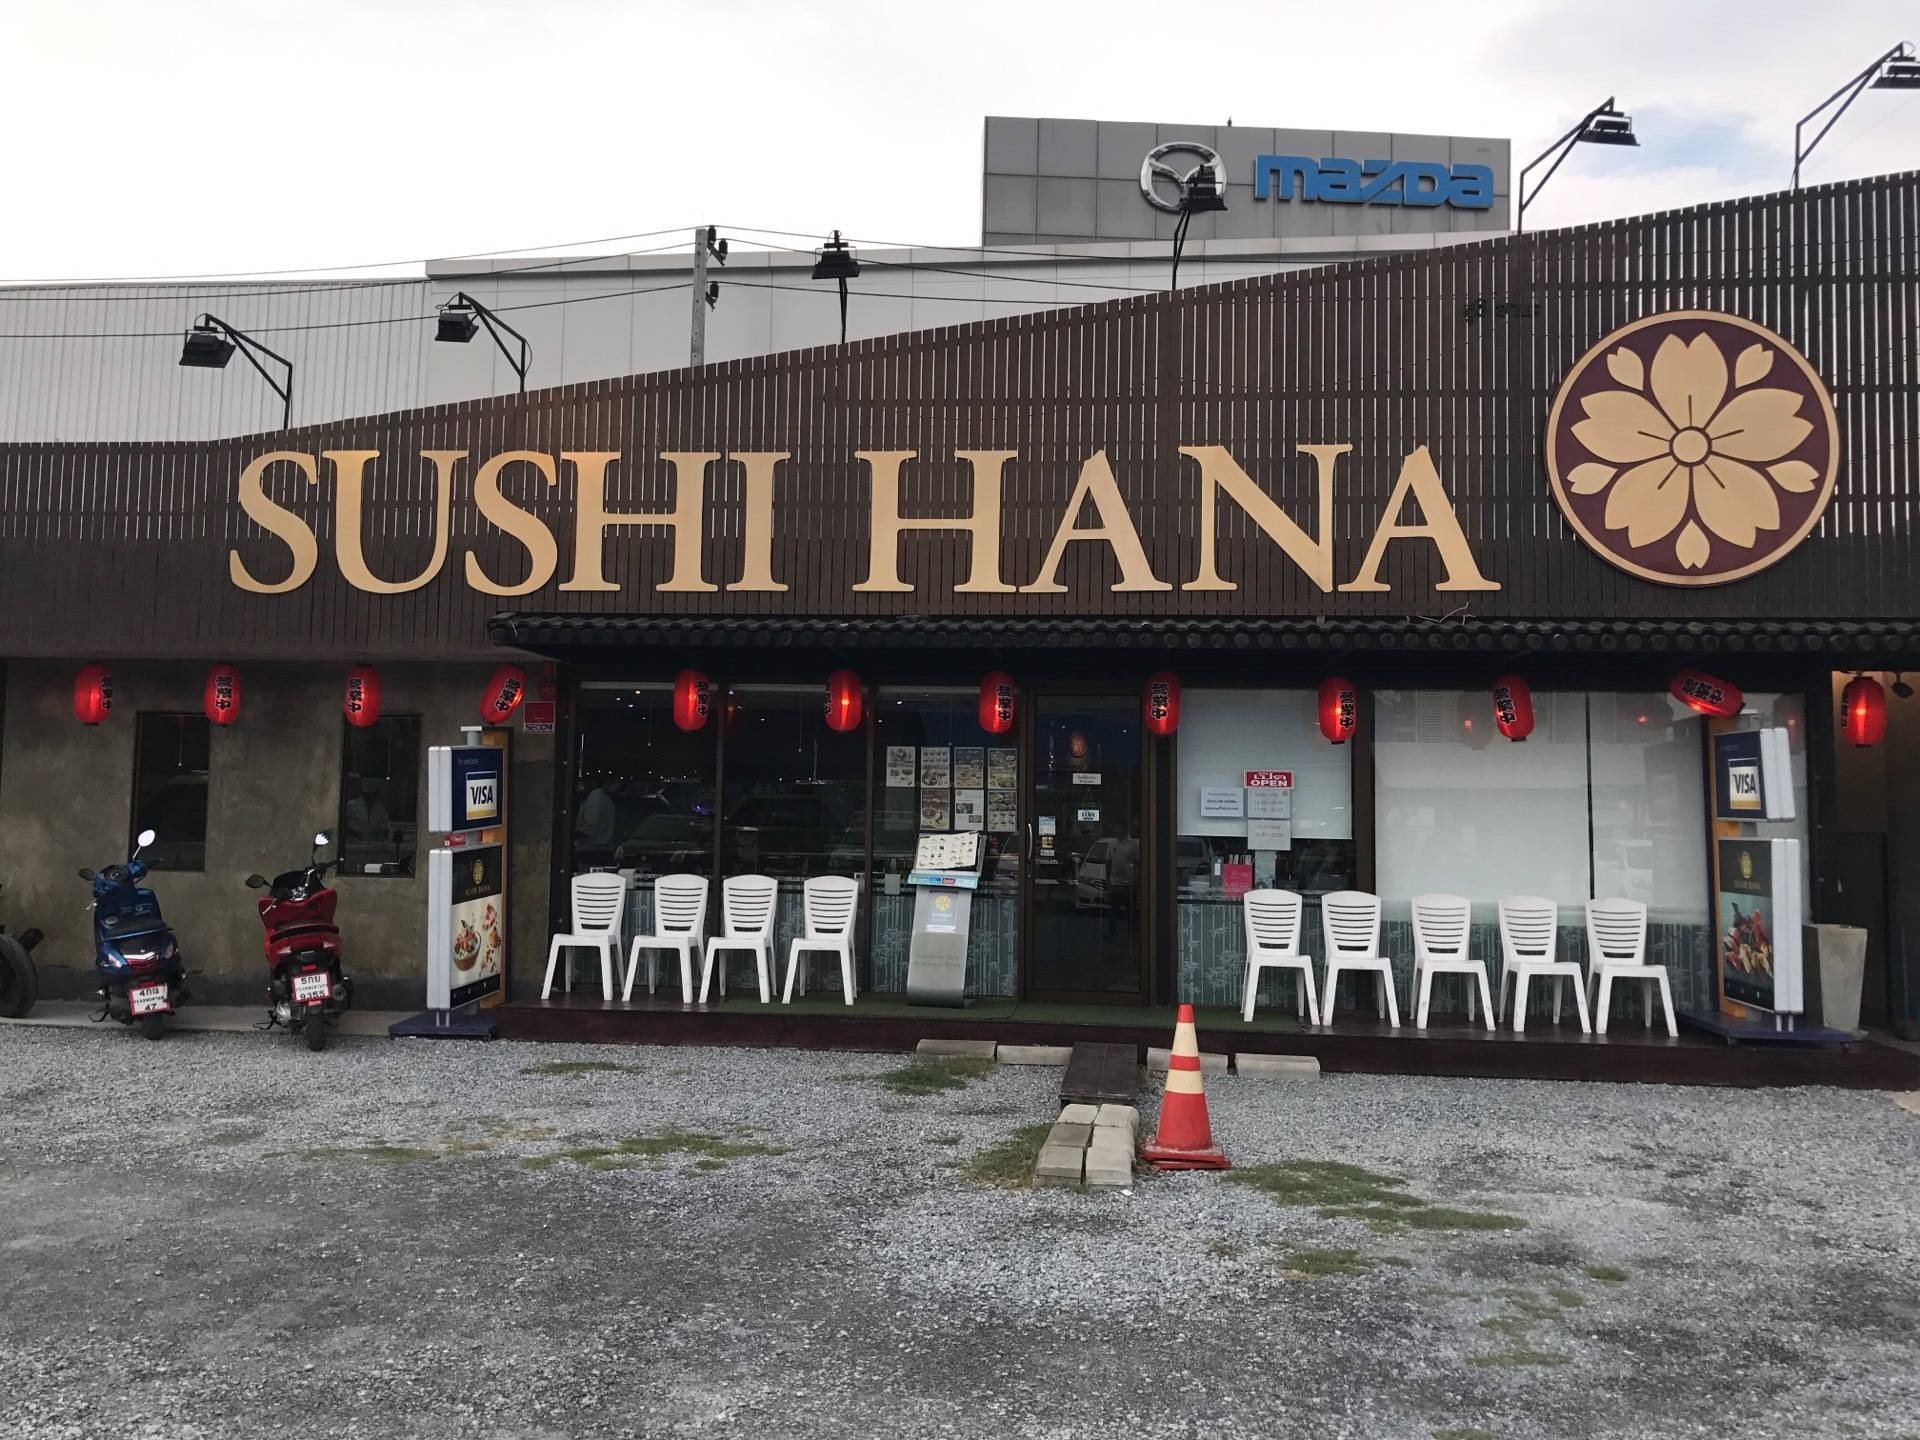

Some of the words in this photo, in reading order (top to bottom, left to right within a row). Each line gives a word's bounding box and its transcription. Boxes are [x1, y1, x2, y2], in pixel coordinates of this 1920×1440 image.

[228, 449, 790, 596] SUSHI
[852, 444, 1502, 595] HANA
[1250, 779, 1288, 787] OPEN
[1733, 774, 1758, 794] VISA
[470, 786, 494, 805] VISA
[144, 1003, 157, 1011] 47
